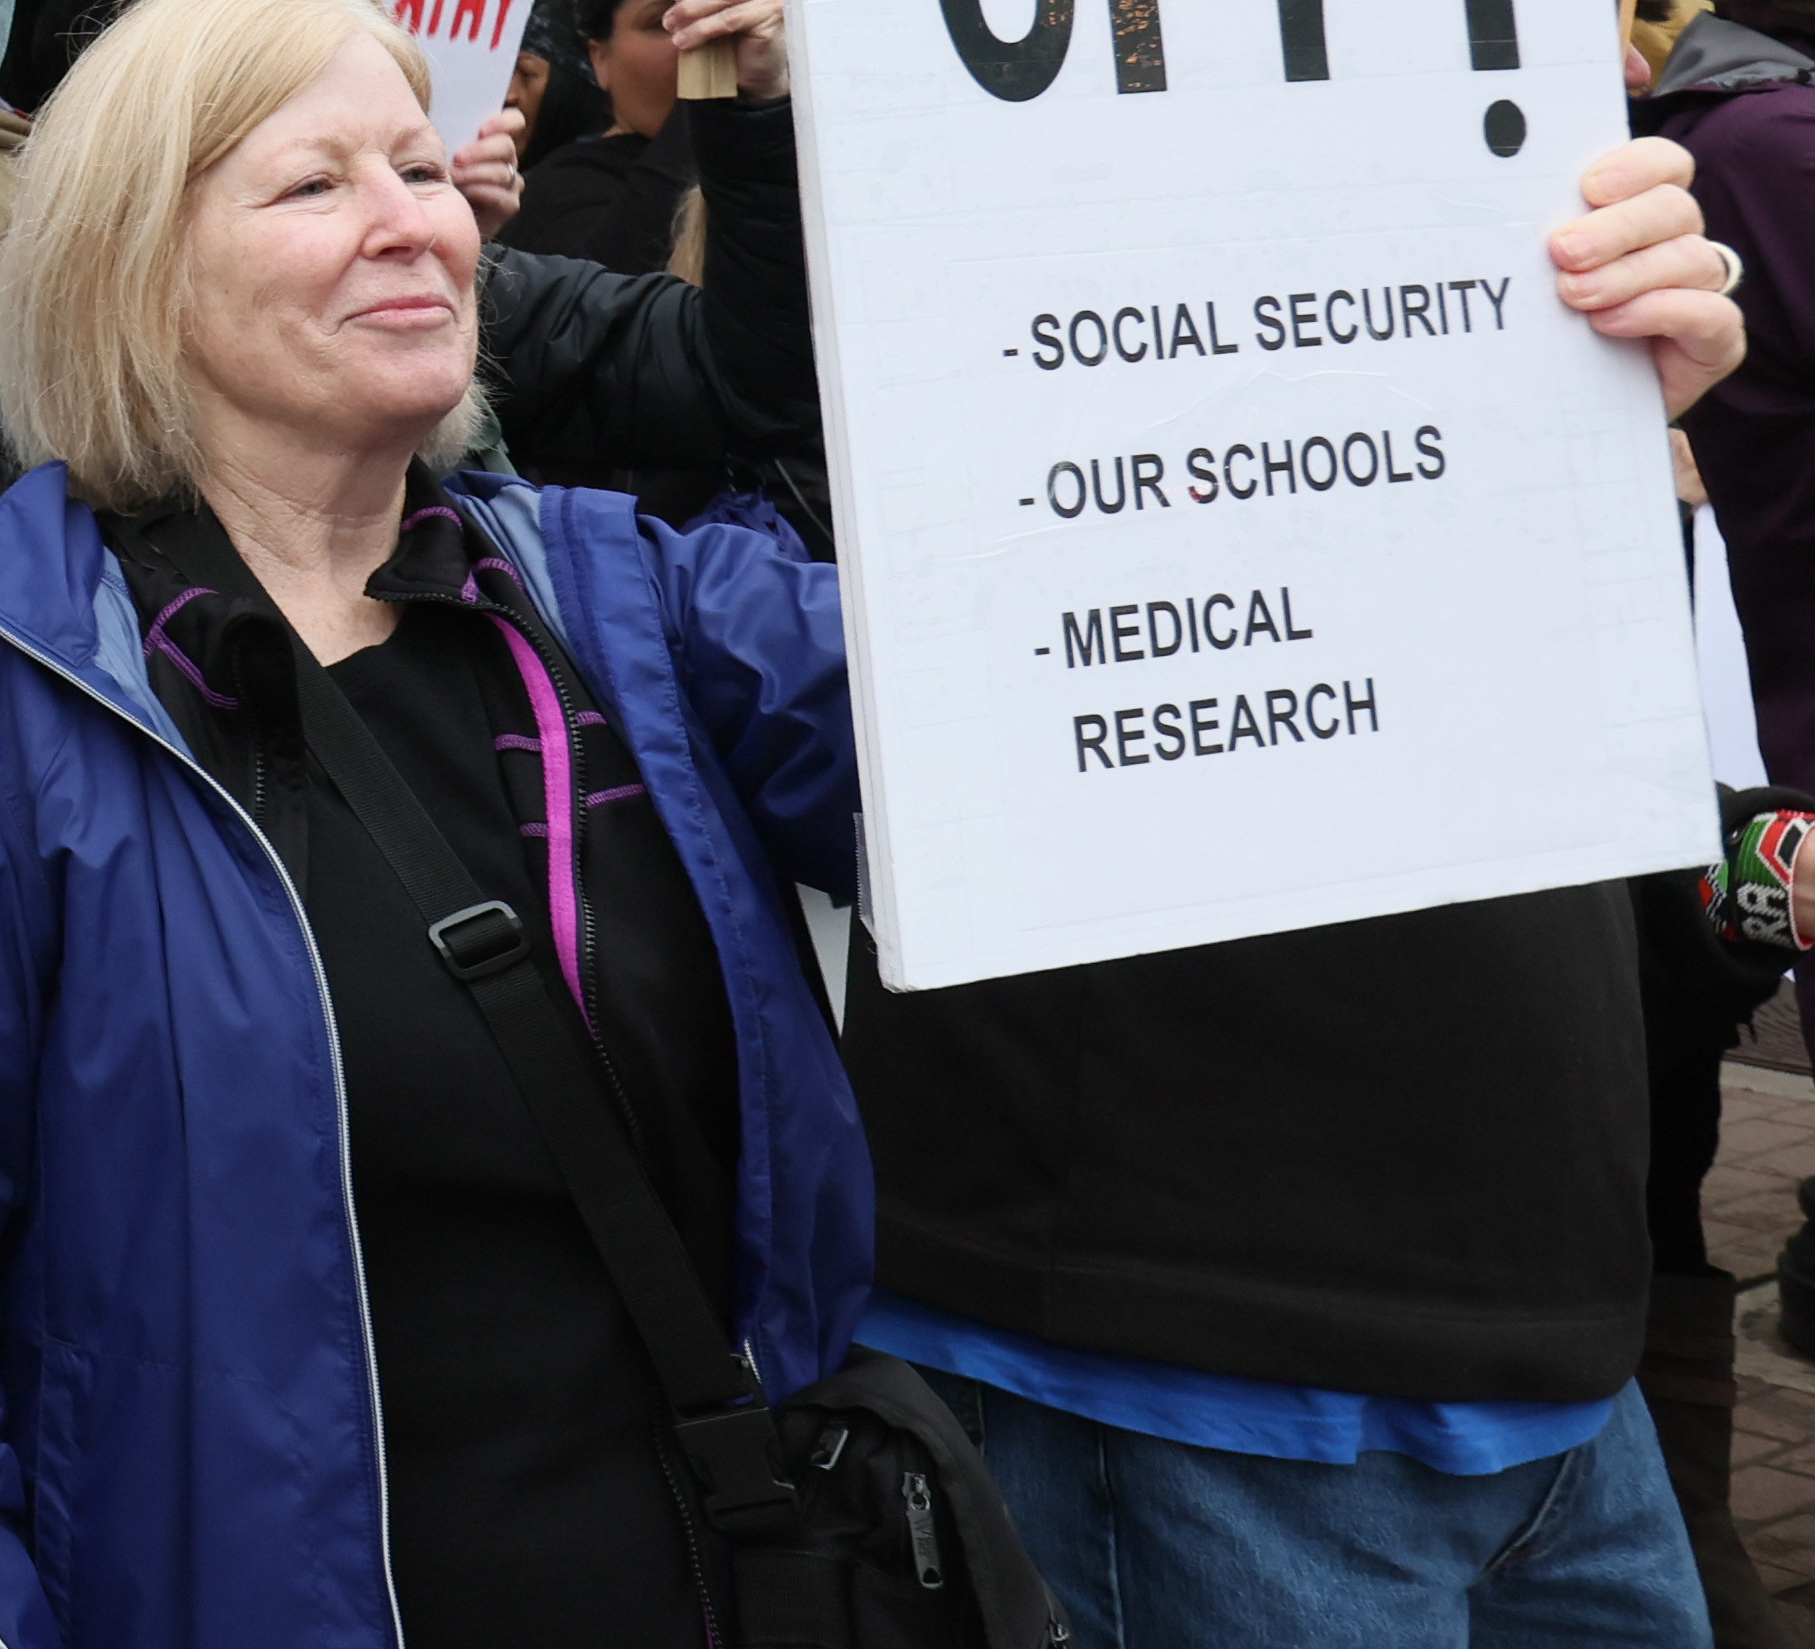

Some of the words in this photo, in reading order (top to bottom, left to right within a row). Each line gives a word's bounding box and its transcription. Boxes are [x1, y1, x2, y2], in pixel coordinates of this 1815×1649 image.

[1253, 277, 1513, 353] SECURITY
[1186, 424, 1446, 504] SCHOOLS
[1073, 677, 1381, 773] RESEARCH
